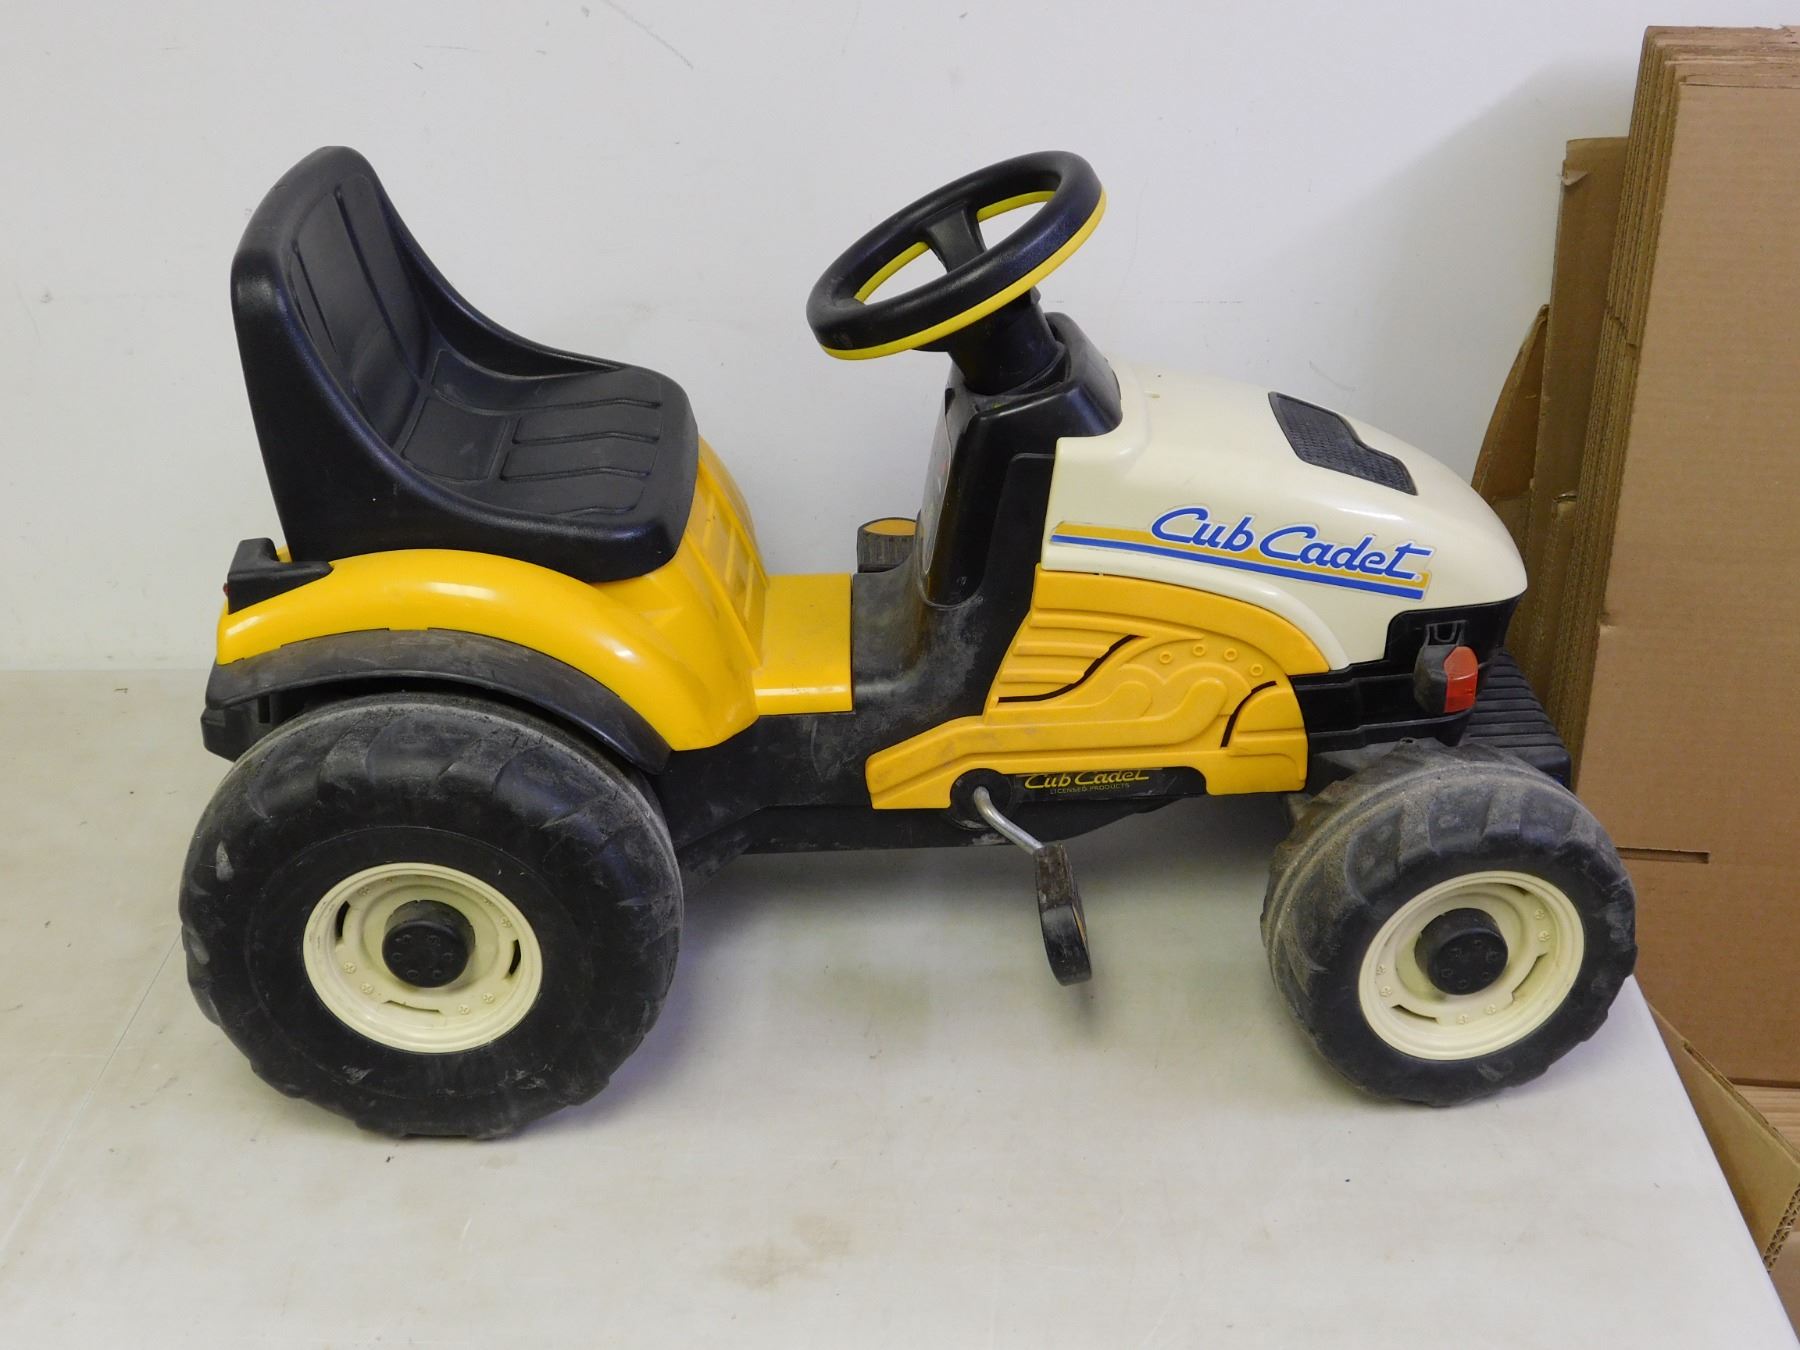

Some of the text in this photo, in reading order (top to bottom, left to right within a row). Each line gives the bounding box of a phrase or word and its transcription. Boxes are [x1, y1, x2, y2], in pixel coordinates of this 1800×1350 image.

[1151, 507, 1432, 580] Cub Cadet
[1024, 773, 1071, 789] Cub
[1050, 783, 1130, 795] LICENSED PRODUCTS
